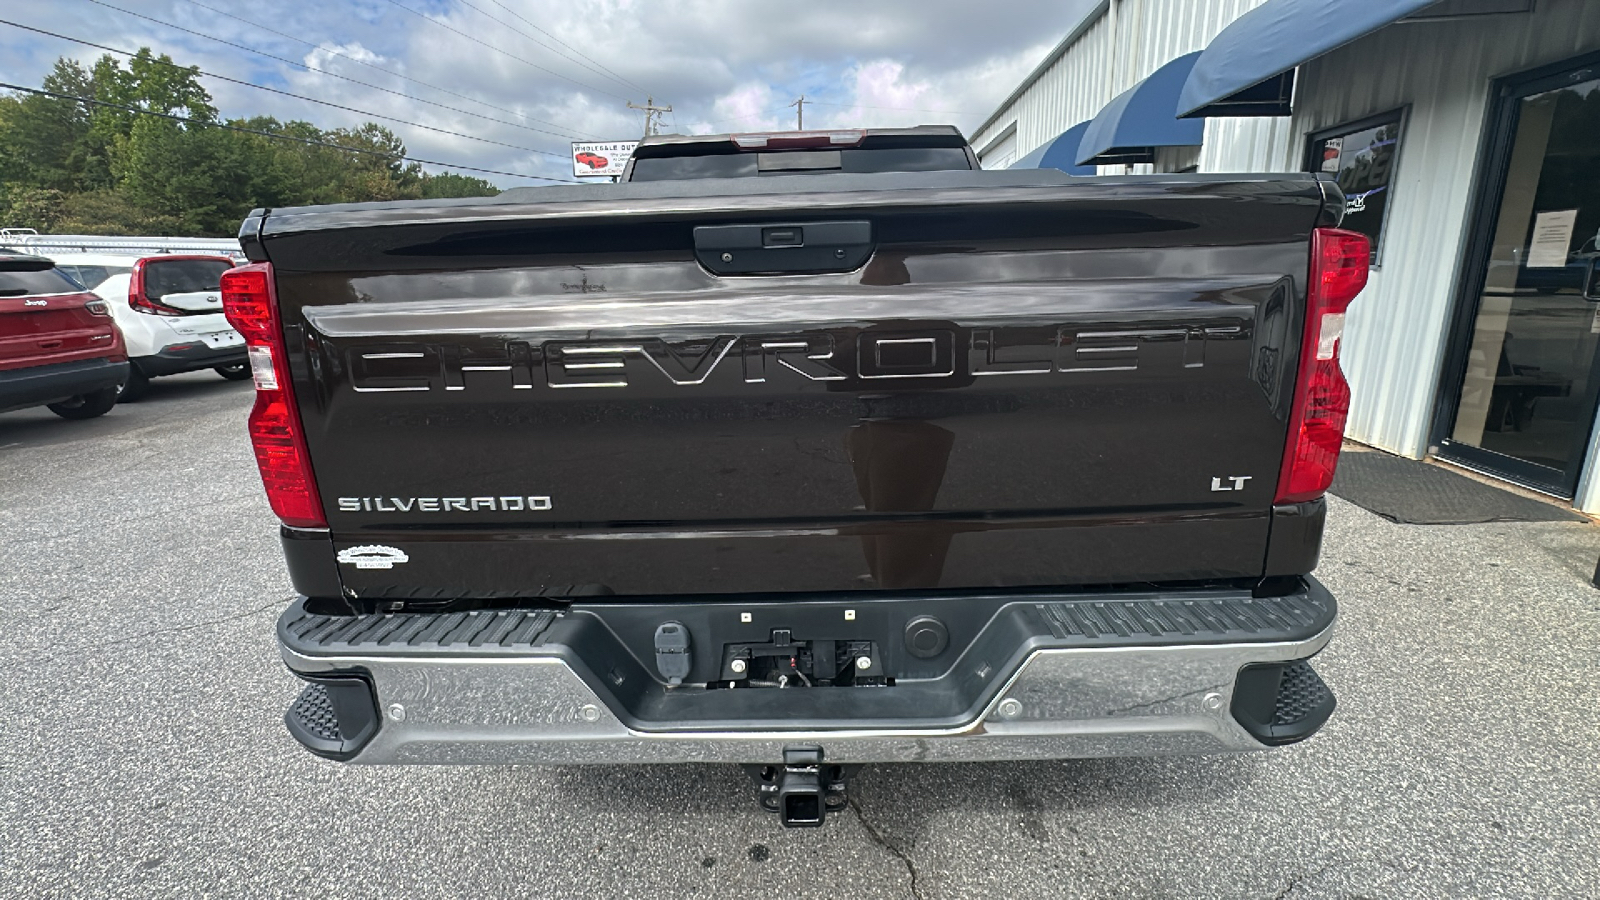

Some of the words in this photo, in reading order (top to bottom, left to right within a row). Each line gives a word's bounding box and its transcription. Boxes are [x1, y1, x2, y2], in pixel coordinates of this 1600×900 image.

[346, 319, 1253, 392] CHEVROLET
[1211, 476, 1253, 491] LT
[338, 496, 553, 512] SILVERADO
